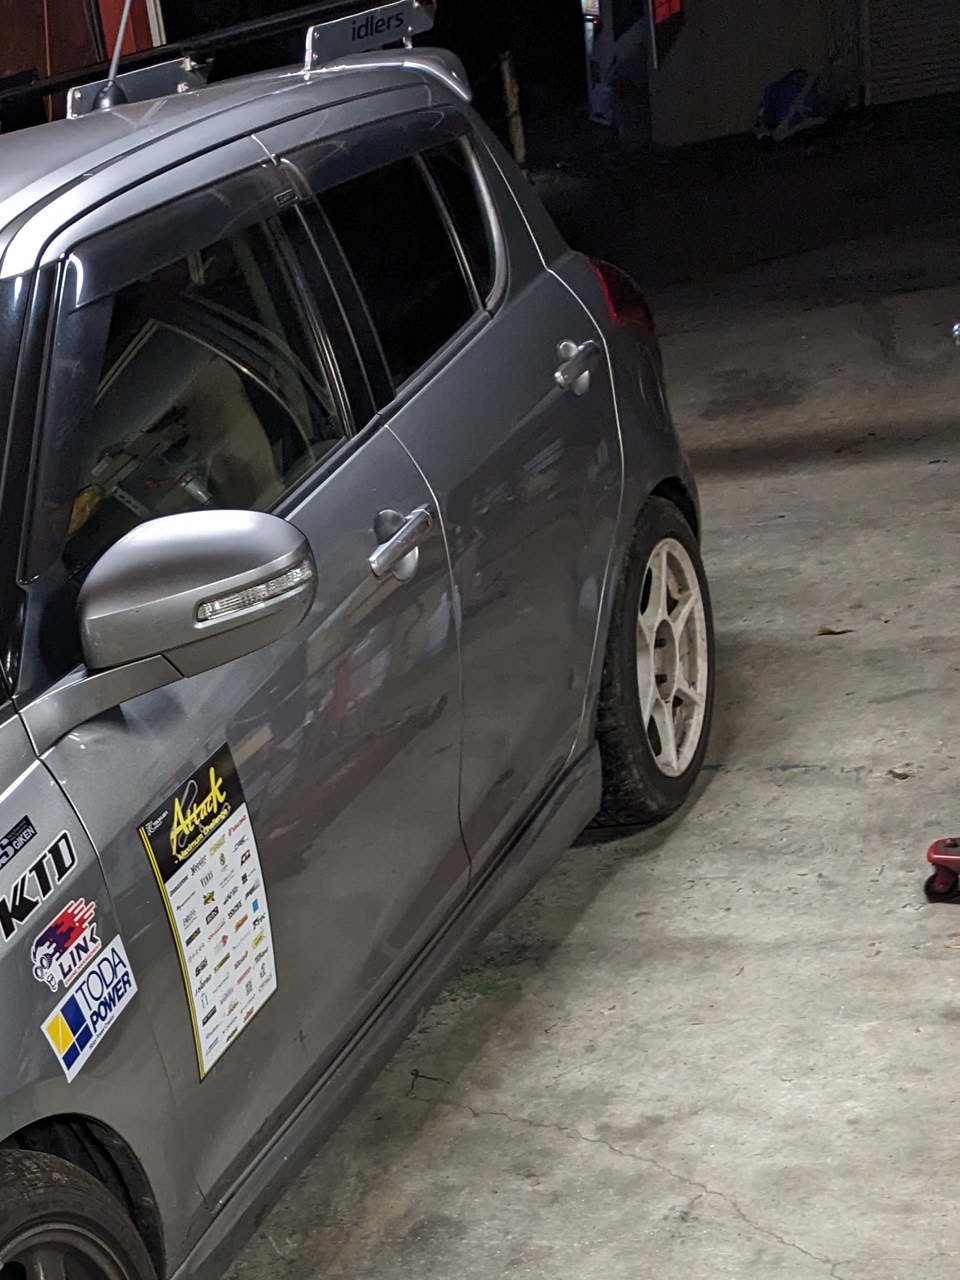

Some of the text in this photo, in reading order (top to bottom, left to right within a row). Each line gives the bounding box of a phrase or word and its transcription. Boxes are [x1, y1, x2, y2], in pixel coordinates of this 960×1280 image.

[352, 12, 404, 41] idlers
[12, 825, 36, 850] GIKEN
[170, 767, 227, 856] Attack
[58, 924, 100, 980] LINK
[75, 947, 127, 1012] TODA
[89, 970, 132, 1034] POWER
